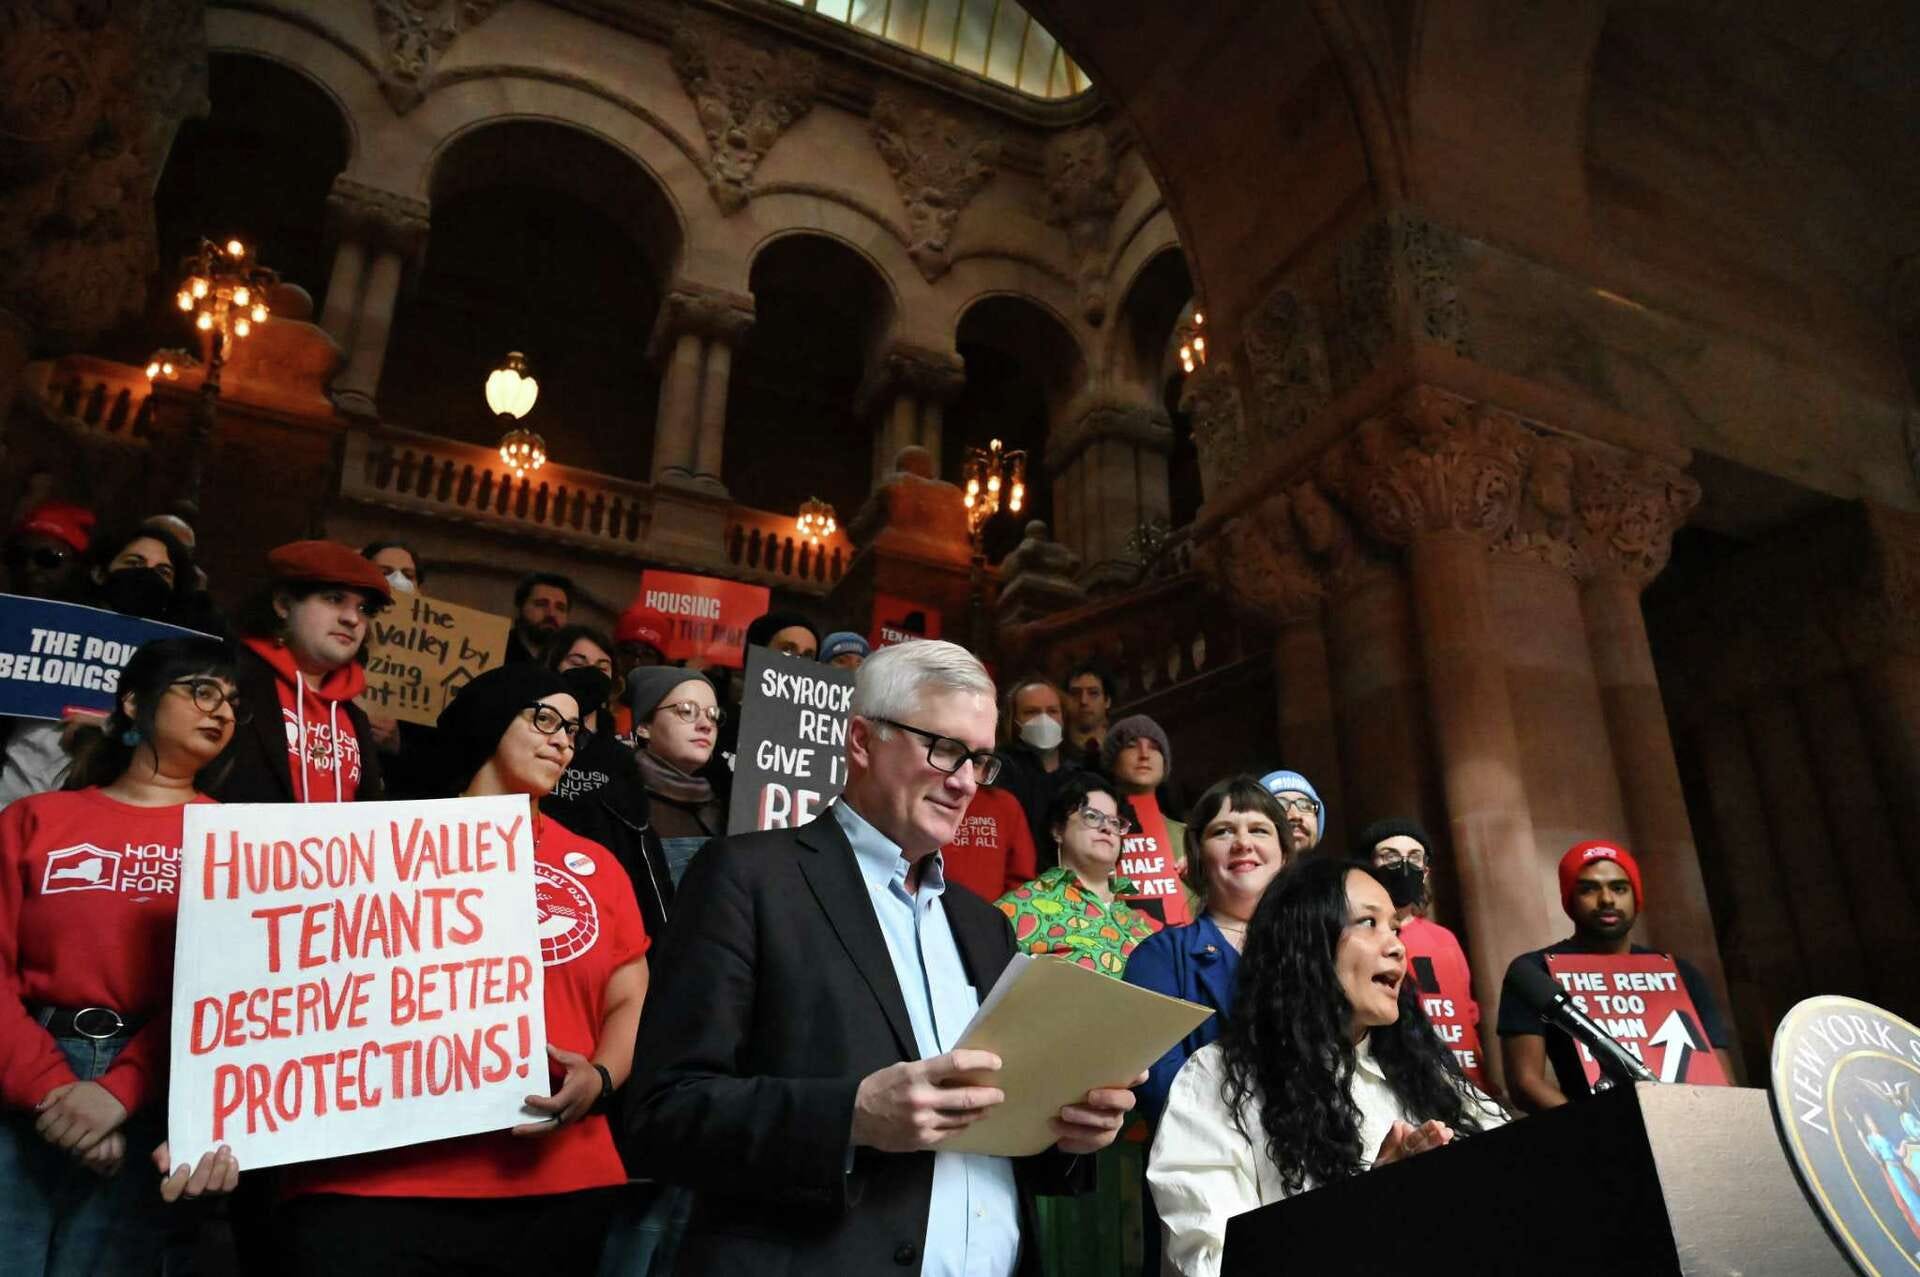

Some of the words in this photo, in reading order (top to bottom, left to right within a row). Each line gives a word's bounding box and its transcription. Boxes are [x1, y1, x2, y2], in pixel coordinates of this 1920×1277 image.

[411, 599, 454, 628] the
[645, 590, 721, 620] HOUSING
[30, 628, 82, 658] THE
[375, 622, 449, 665] Valley
[458, 636, 490, 670] by
[0, 653, 121, 693] BELONGS
[761, 668, 855, 712] SKYROCK
[800, 710, 848, 746] REN
[756, 740, 815, 777] GIVE
[758, 783, 839, 831] RE
[203, 831, 376, 900] HUDSON
[390, 815, 523, 882] VALLEY
[976, 837, 998, 849] ALL
[123, 861, 183, 878] JUS
[1121, 857, 1165, 875] HALF
[121, 876, 175, 894] FOR
[252, 887, 484, 973] TENANTS
[1556, 972, 1607, 991] THE
[1613, 972, 1677, 991] RENT
[190, 972, 376, 1056] DESERVE
[390, 955, 533, 1026] BETTER
[1572, 995, 1589, 1014] S
[1595, 995, 1645, 1014] TOO
[1596, 1018, 1648, 1038] AMN
[1809, 1014, 1904, 1056] YORK
[212, 1015, 531, 1142] PROTECTIONS!
[1793, 1037, 1829, 1135] NEW
